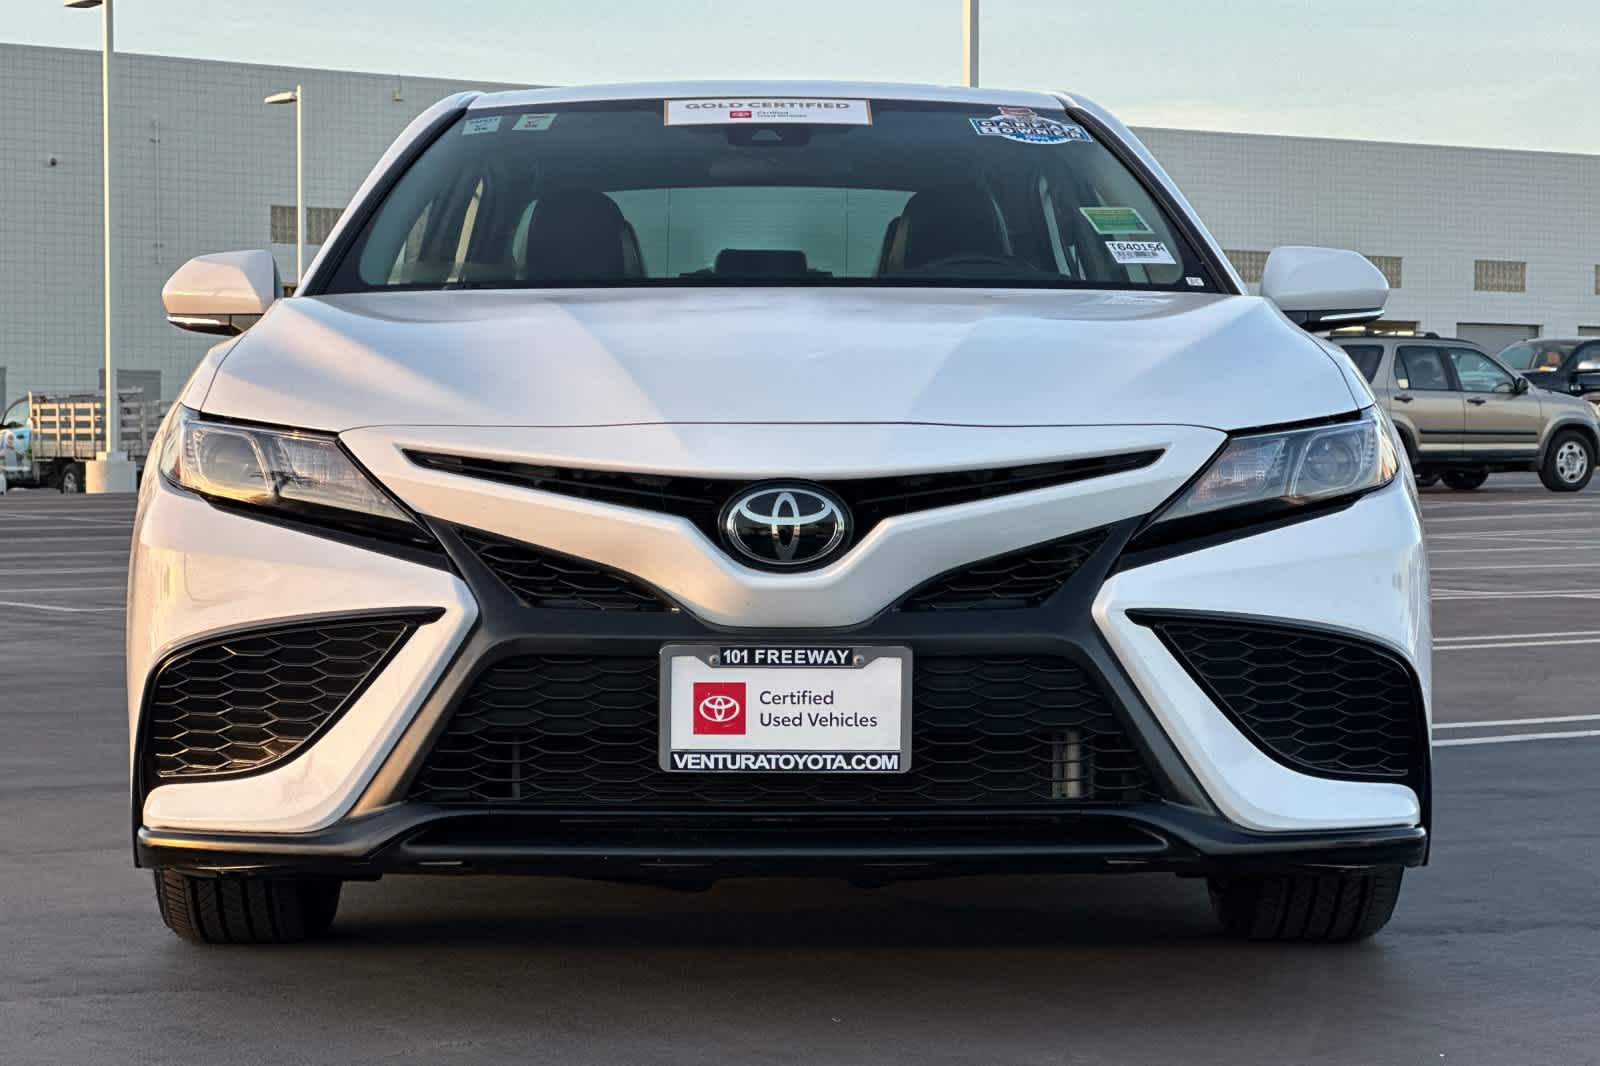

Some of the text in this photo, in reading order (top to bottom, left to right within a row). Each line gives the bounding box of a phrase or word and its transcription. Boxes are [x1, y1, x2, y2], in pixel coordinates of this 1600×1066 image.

[748, 101, 850, 110] CERTIFIED
[1108, 242, 1164, 252] T64015A
[723, 649, 849, 665] 101 FREEWAY
[759, 690, 834, 705] Certified
[759, 712, 878, 727] Used Vehicles
[673, 753, 899, 770] VENTURATOYOTA.COM
